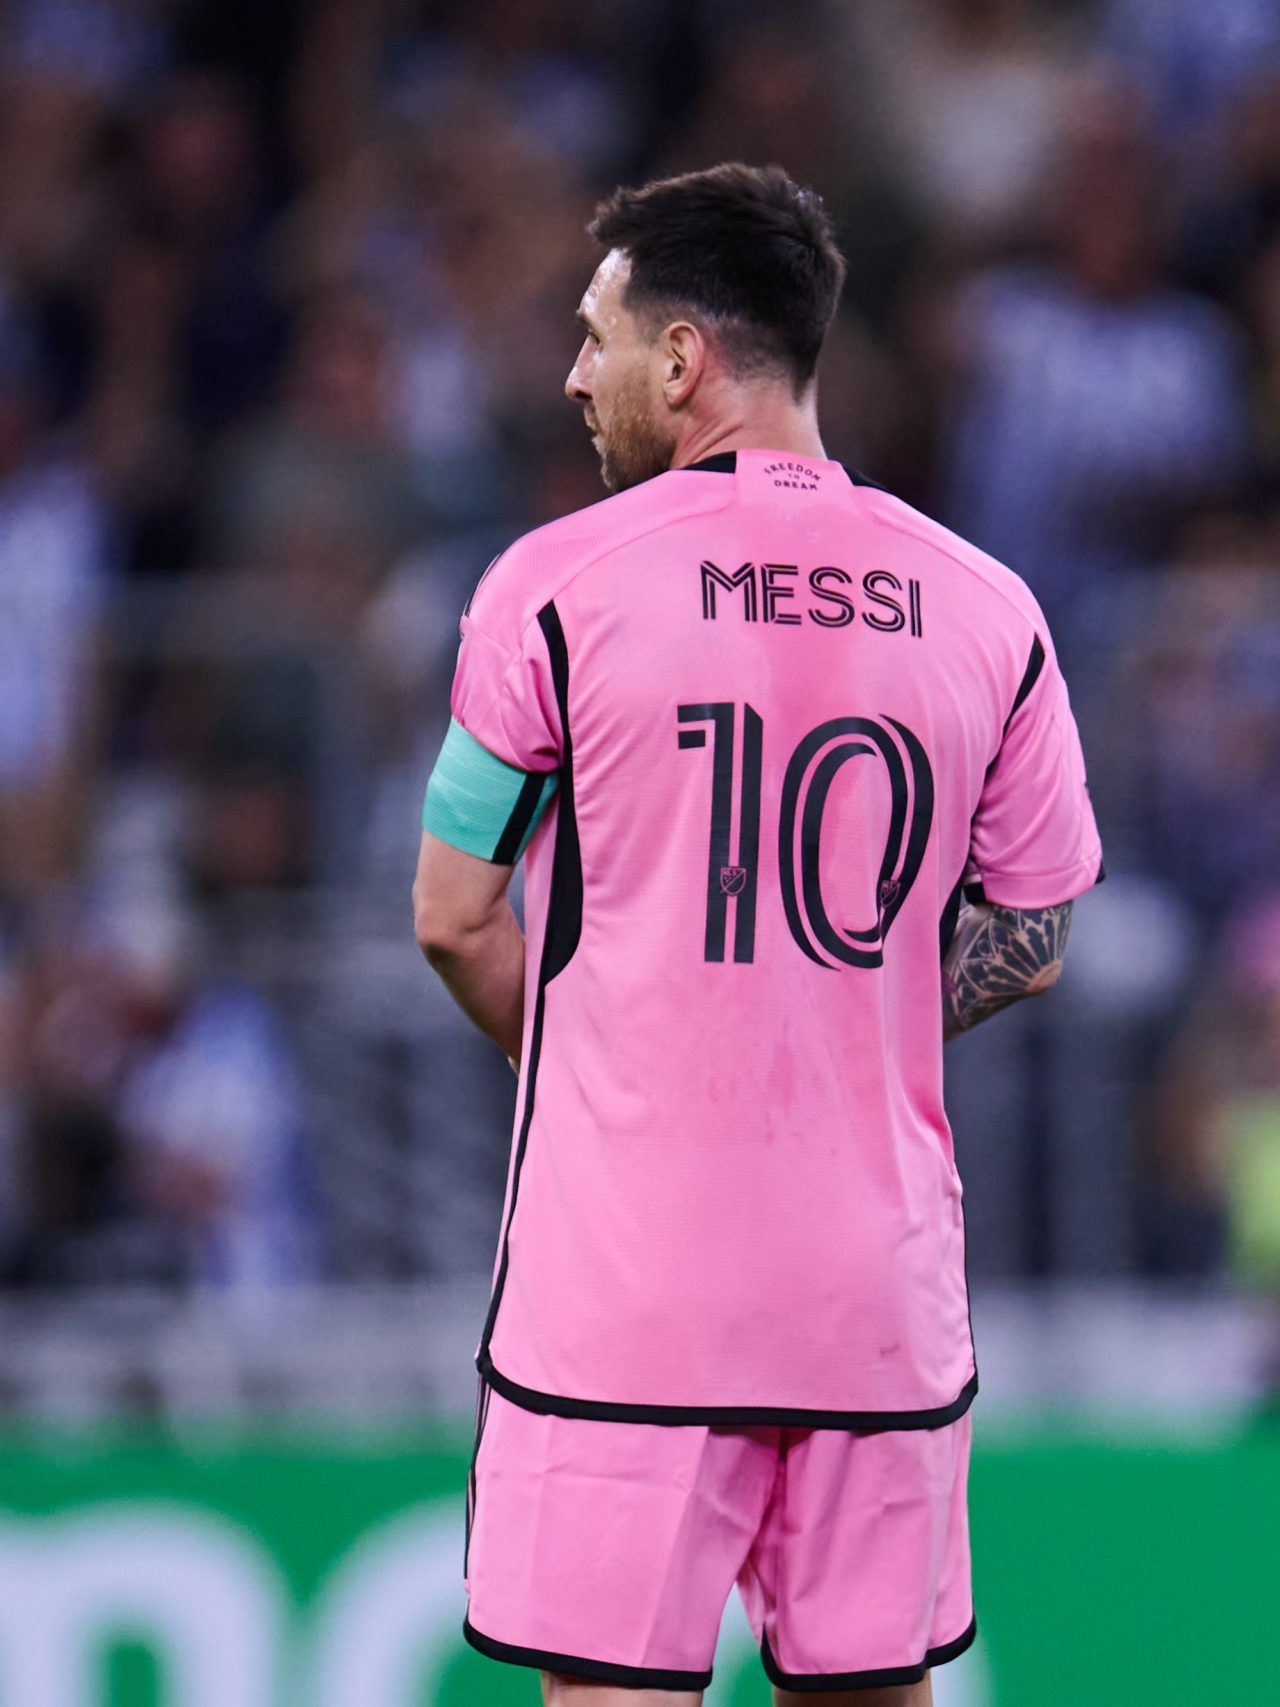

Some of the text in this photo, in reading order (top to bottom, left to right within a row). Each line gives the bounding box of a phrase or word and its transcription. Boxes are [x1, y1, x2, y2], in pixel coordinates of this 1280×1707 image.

[763, 462, 821, 481] FREEDOM
[774, 480, 818, 491] DREAM
[700, 560, 923, 639] MESSI
[677, 702, 935, 971] 10
